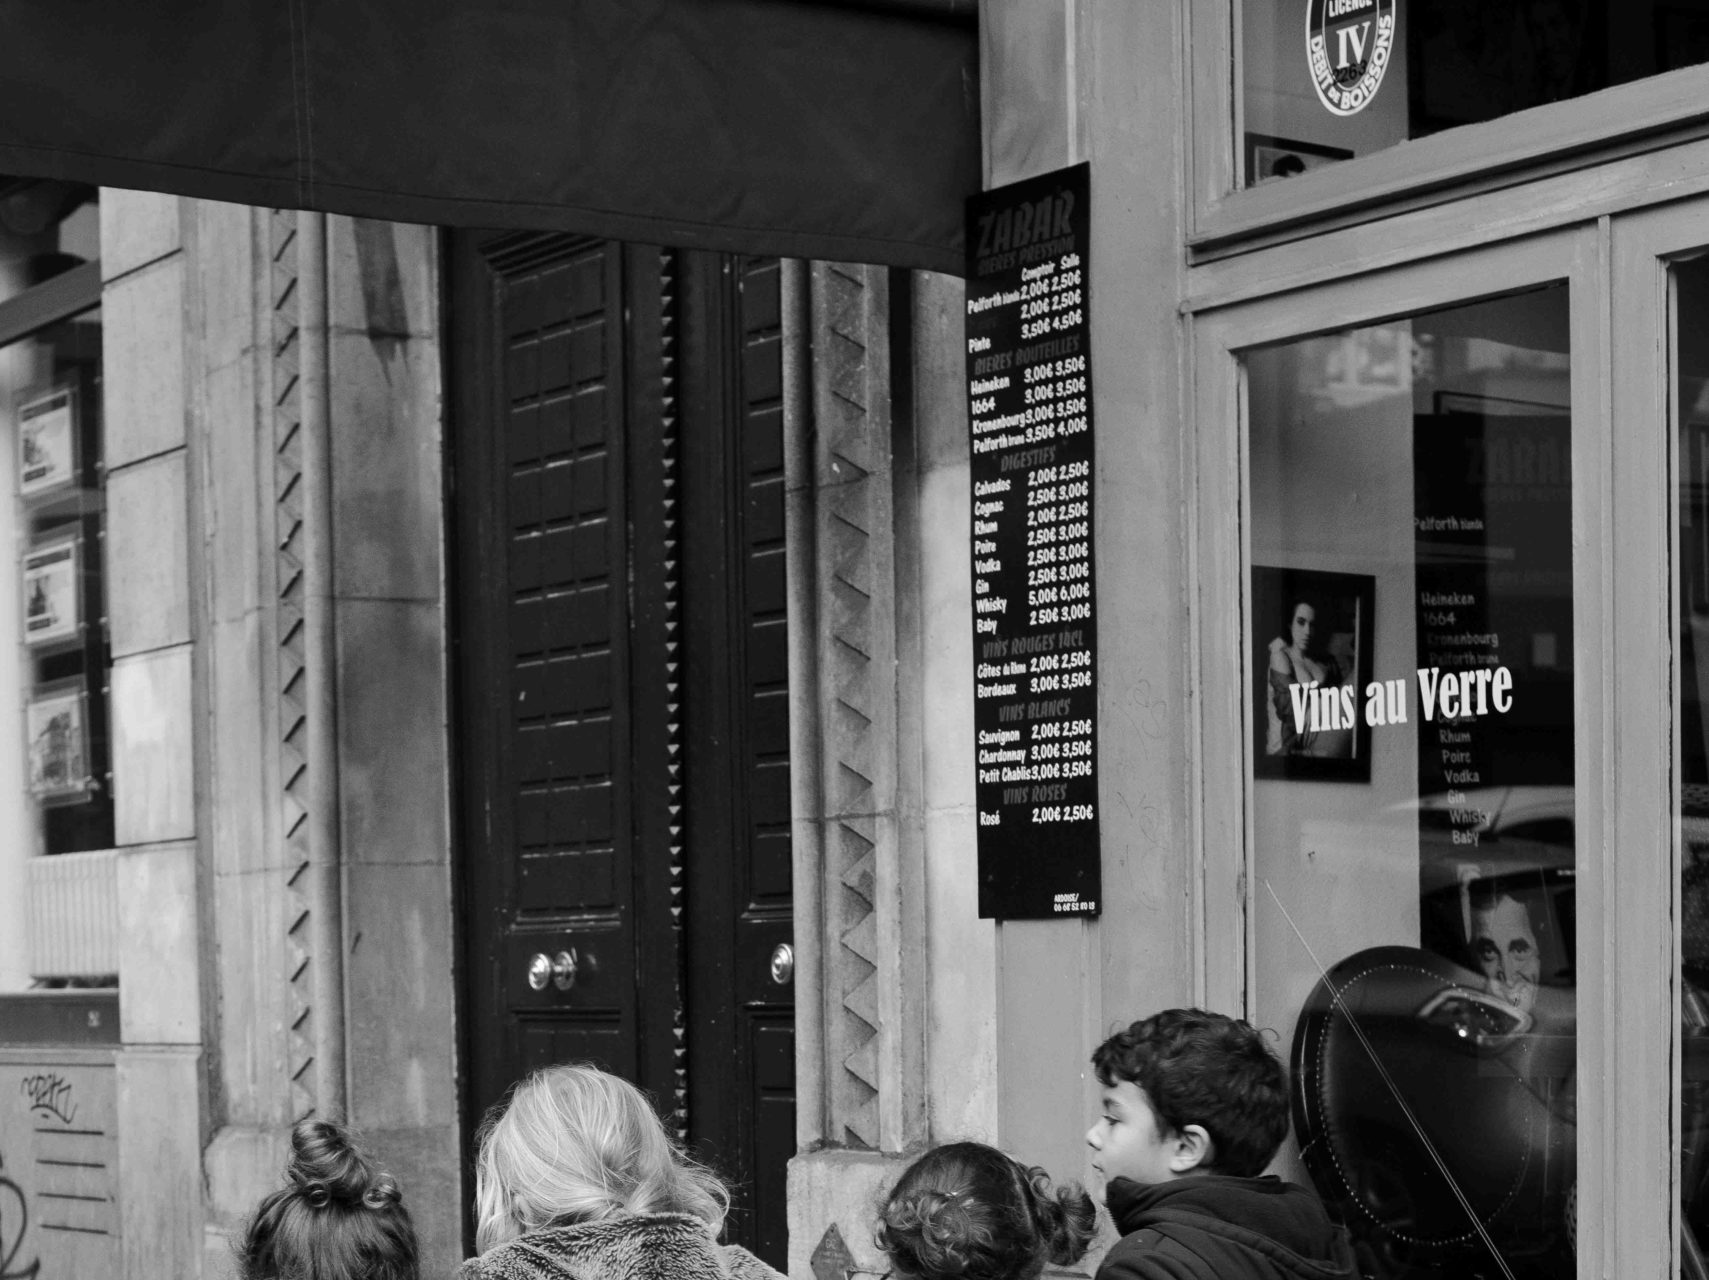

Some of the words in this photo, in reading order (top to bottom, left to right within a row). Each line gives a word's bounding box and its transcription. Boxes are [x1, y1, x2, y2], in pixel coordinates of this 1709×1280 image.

[1336, 21, 1371, 69] IV
[1311, 34, 1334, 91] DEBIT
[1340, 15, 1391, 109] BOISSONS
[976, 189, 1074, 258] ZABAR
[968, 292, 1002, 314] Pelforth
[1020, 278, 1049, 300] 2,00€
[1051, 269, 1081, 291] 2,50€
[1020, 298, 1049, 319] 2,00€
[1052, 288, 1082, 310] 2,50€
[1020, 317, 1050, 339] 3,50€
[1052, 308, 1082, 330] 4,50€
[975, 351, 1012, 376] BIERES
[1016, 333, 1080, 366] BOUTEILLES
[970, 376, 1010, 395] Heineken
[1024, 362, 1053, 384] 3,00€
[1055, 354, 1086, 376] 3,50€
[972, 396, 996, 415] 1664
[1024, 384, 1054, 404] 3,00€
[1056, 376, 1086, 397] 3,50€
[972, 412, 1025, 434] Kronenbourg
[1025, 404, 1054, 424] 3,00€
[1056, 397, 1086, 418] 3,50€
[974, 433, 1008, 454] Pelforth
[1025, 423, 1055, 444] 3,50€
[1056, 416, 1087, 436] 4,00€
[1001, 445, 1056, 472] DIGESTIFS
[974, 478, 1011, 496] Calvados
[1028, 466, 1057, 486] 2,00€
[1059, 460, 1089, 480] 2,50€
[974, 500, 1004, 518] Cognac
[1027, 486, 1056, 506] 2,50€
[1058, 480, 1088, 500] 3,00€
[974, 520, 998, 535] Rhum
[1027, 506, 1056, 526] 2,00€
[1058, 500, 1088, 521] 2,50€
[974, 539, 996, 555] Poire
[1027, 526, 1056, 546] 2,50€
[1058, 521, 1088, 542] 3,00€
[975, 558, 1001, 574] Vodka
[1027, 547, 1056, 567] 2,50€
[1058, 542, 1088, 562] 3,00€
[976, 578, 990, 594] Gin
[1028, 566, 1057, 586] 2,50€
[1059, 562, 1089, 582] 3,00€
[976, 596, 1007, 614] Whisky
[1028, 587, 1058, 606] 5,00€
[1060, 582, 1090, 602] 6,00€
[1421, 592, 1475, 606] Heineken
[976, 618, 998, 635] Baby
[1060, 602, 1090, 622] 3,00€
[984, 639, 1008, 658] VINS
[1011, 633, 1056, 655] ROUGES
[1030, 654, 1059, 674] 2,00€
[1061, 650, 1091, 670] 2,50€
[978, 682, 1016, 698] Bordeaux
[1030, 674, 1059, 694] 3,00€
[1062, 670, 1092, 690] 3,50€
[1000, 703, 1025, 722] VINS
[1028, 698, 1071, 720] BLANCS
[1289, 680, 1355, 734] Vins
[1365, 679, 1408, 727] au
[1417, 666, 1512, 720] Verre
[978, 728, 1020, 746] Sauvignon
[1031, 722, 1060, 740] 2,00€
[1062, 718, 1092, 738] 2,50€
[1440, 728, 1470, 743] Rhum
[979, 749, 1026, 764] Chardonnay
[1030, 743, 1060, 761] 3,00€
[1062, 740, 1092, 759] 3,50€
[1442, 749, 1471, 764] Poire
[980, 768, 1000, 784] Petit
[1002, 766, 1031, 782] Chablis
[1031, 763, 1060, 782] 3,00€
[1062, 760, 1092, 779] 3,50€
[1444, 770, 1480, 783] Vodka
[1003, 787, 1028, 804] VINS
[1032, 783, 1068, 803] ROSES
[1448, 789, 1465, 804] Gin
[980, 810, 1000, 826] Rosé
[1032, 806, 1060, 824] 2,00€
[1063, 804, 1094, 823] 2,50€
[1450, 808, 1491, 826] Whisky
[1452, 829, 1480, 847] Baby
